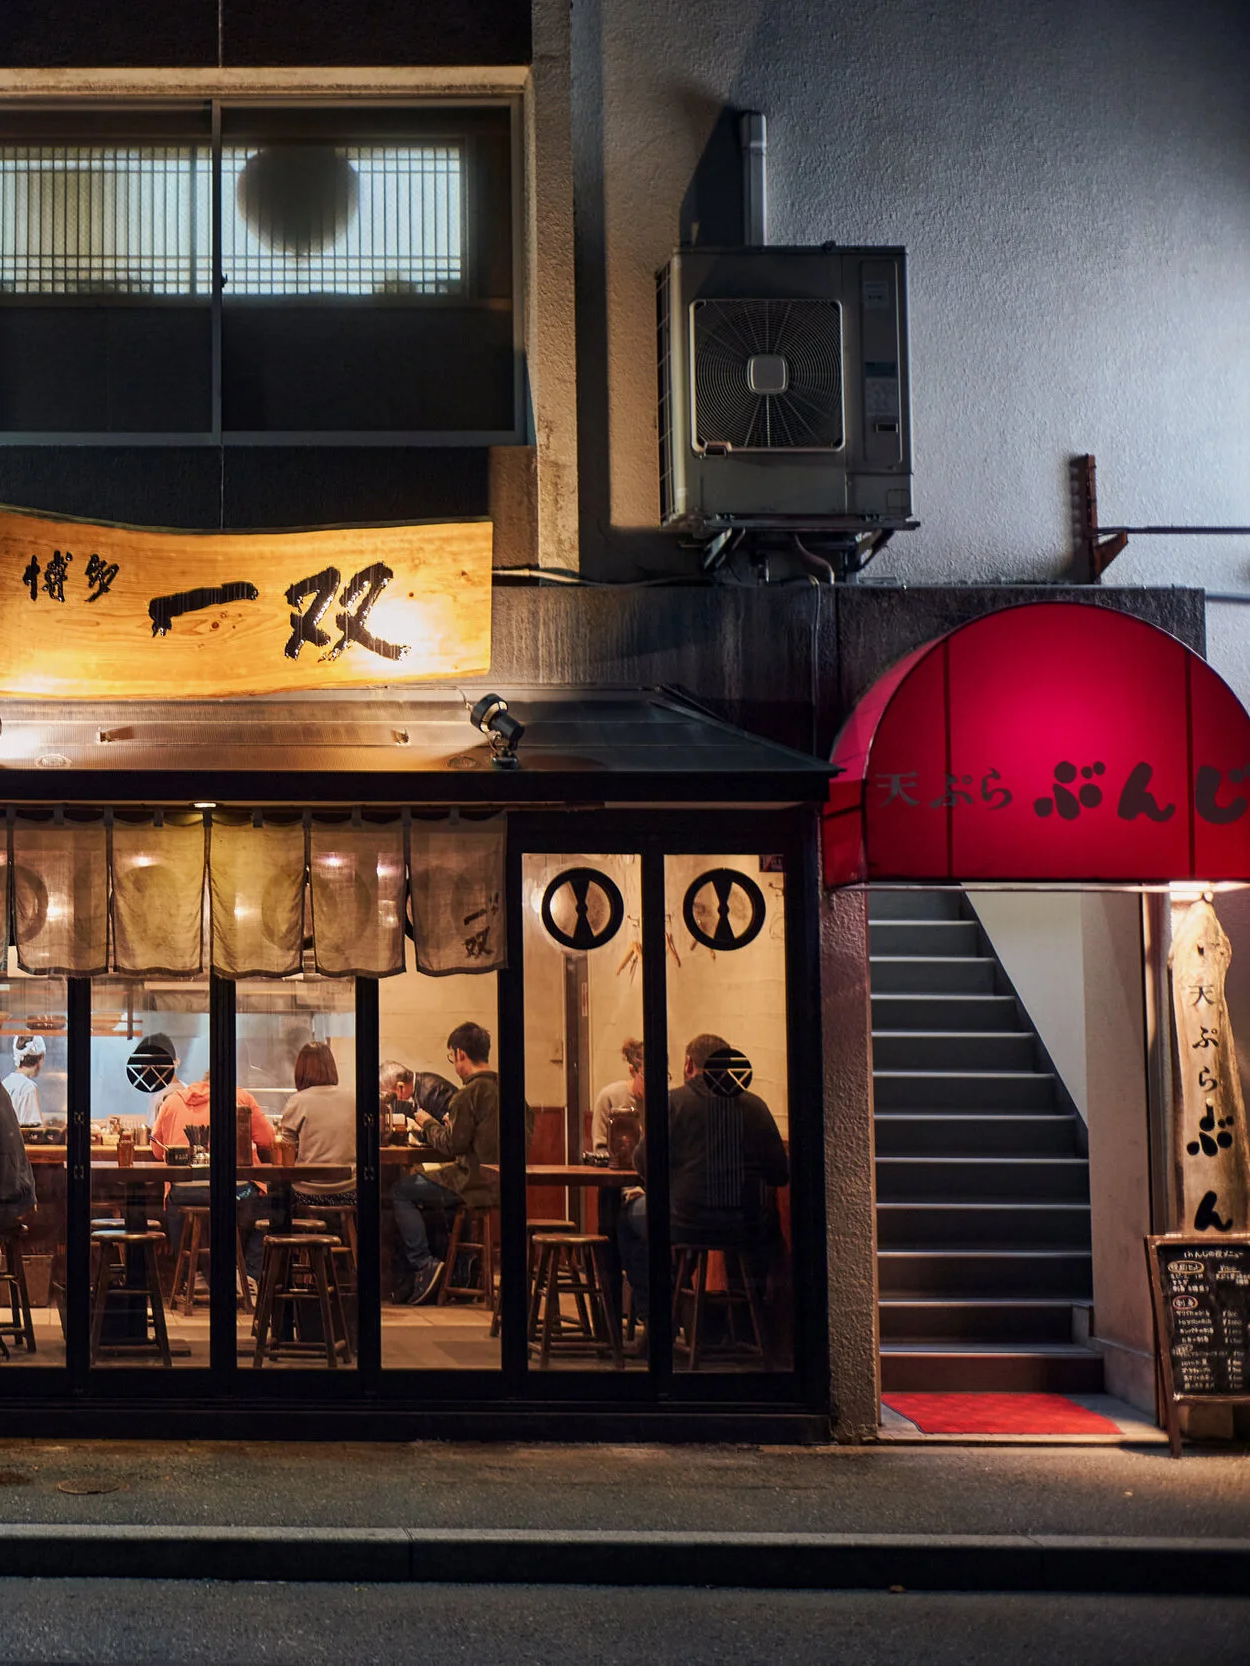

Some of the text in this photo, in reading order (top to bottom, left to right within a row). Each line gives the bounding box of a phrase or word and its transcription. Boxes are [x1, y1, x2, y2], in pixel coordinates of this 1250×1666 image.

[22, 549, 412, 663] 博多 一双
[875, 760, 1250, 826] 天ぷら ぶんじ
[1188, 985, 1220, 1092] 天ぷら
